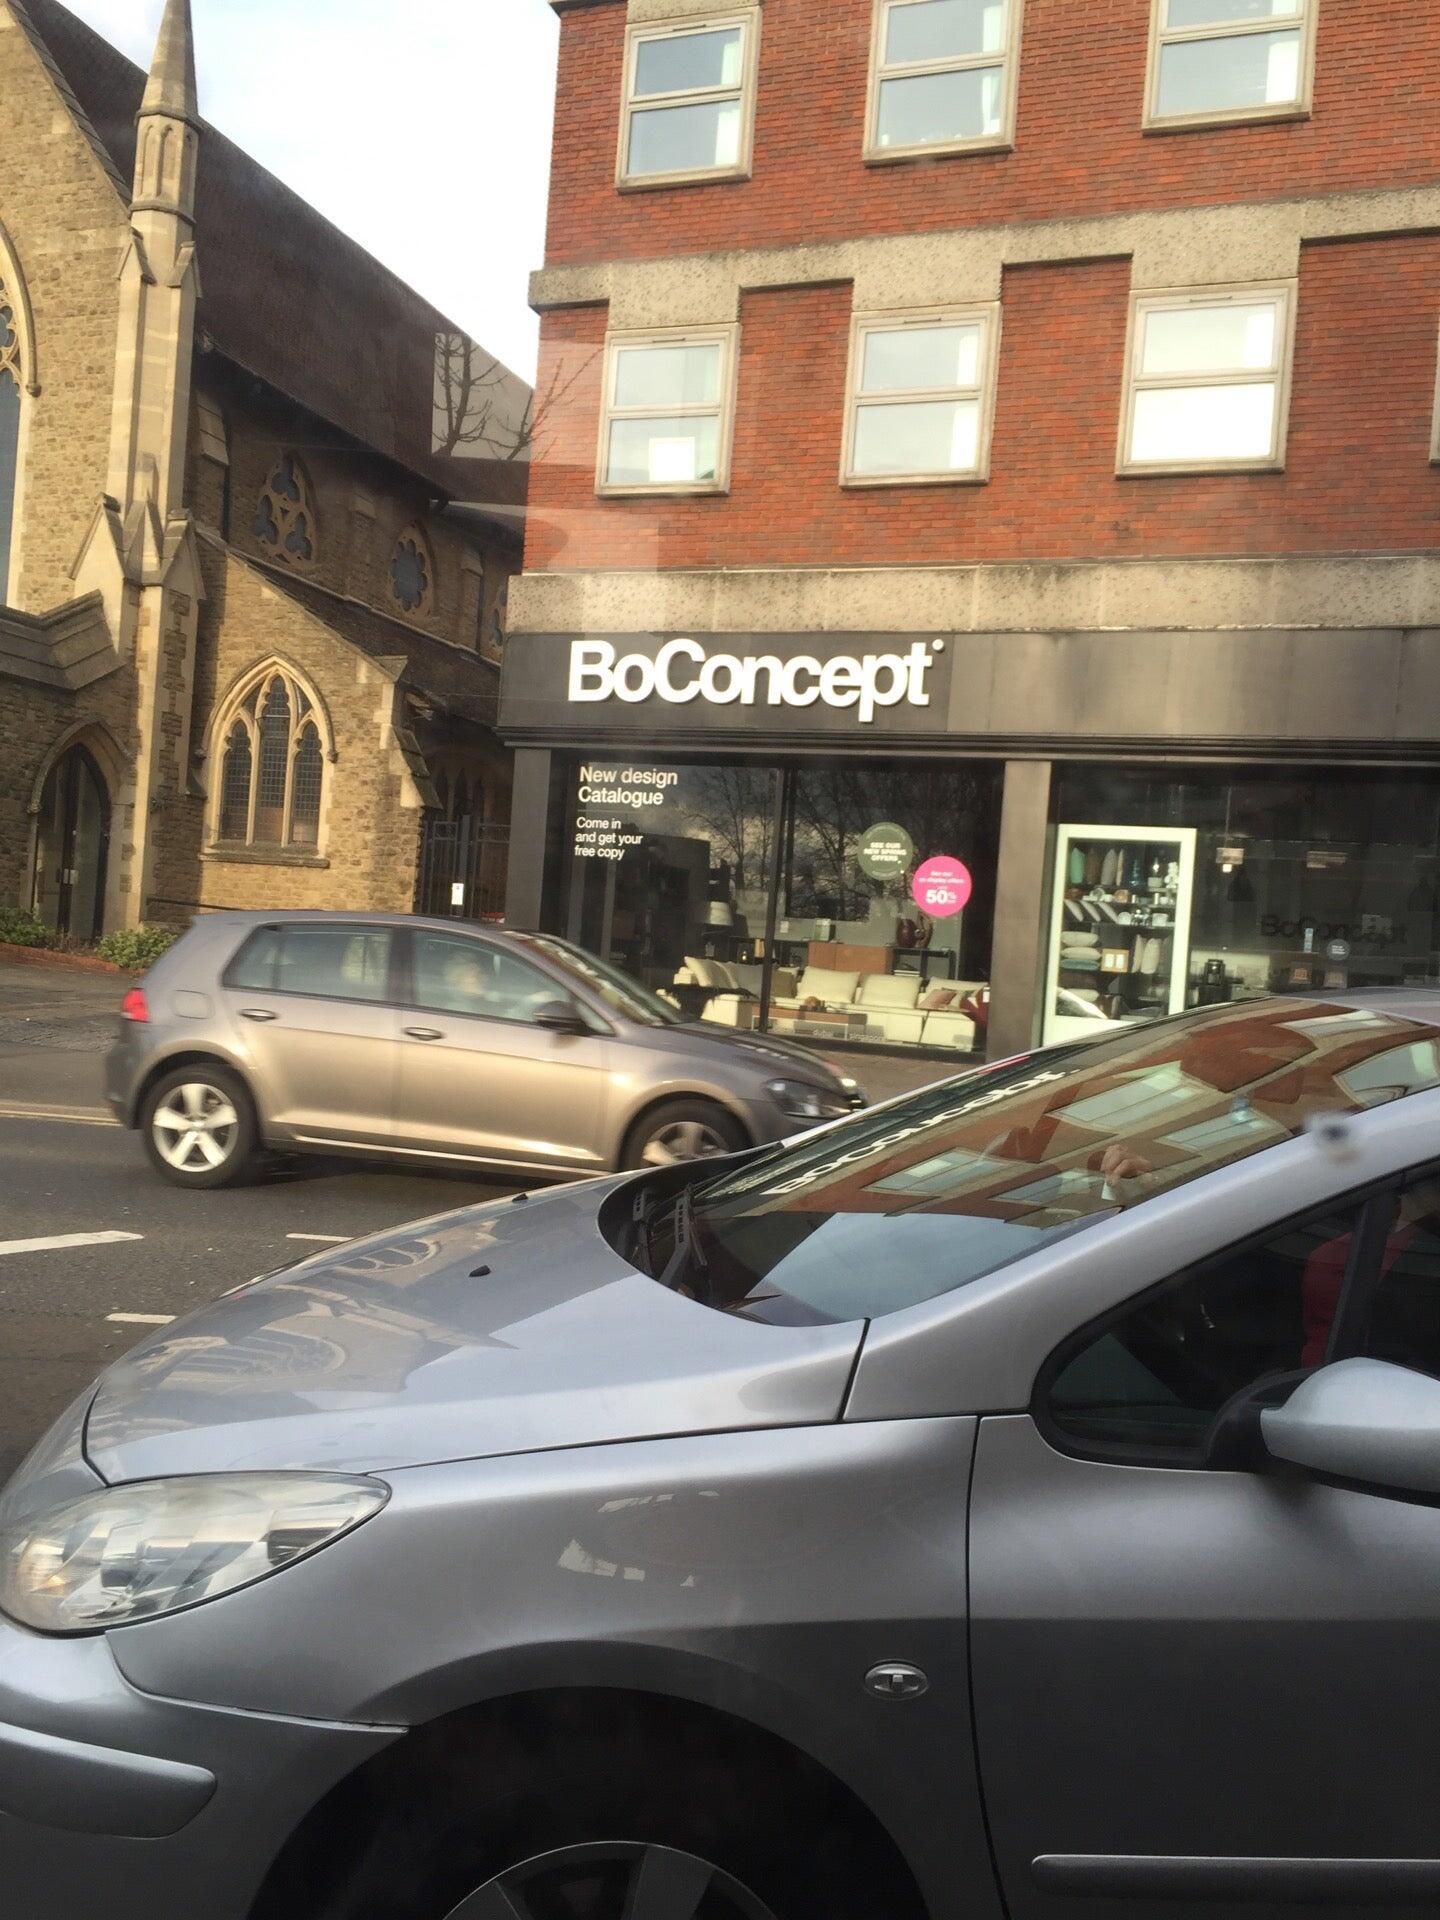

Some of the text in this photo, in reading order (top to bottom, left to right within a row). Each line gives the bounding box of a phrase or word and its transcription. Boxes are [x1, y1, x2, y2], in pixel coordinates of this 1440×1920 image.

[568, 638, 932, 723] BoConcept
[579, 766, 679, 788] New design
[578, 786, 664, 808] Catalogue
[576, 816, 622, 830] Come in
[575, 832, 644, 846] and get your
[574, 845, 625, 861] free copy
